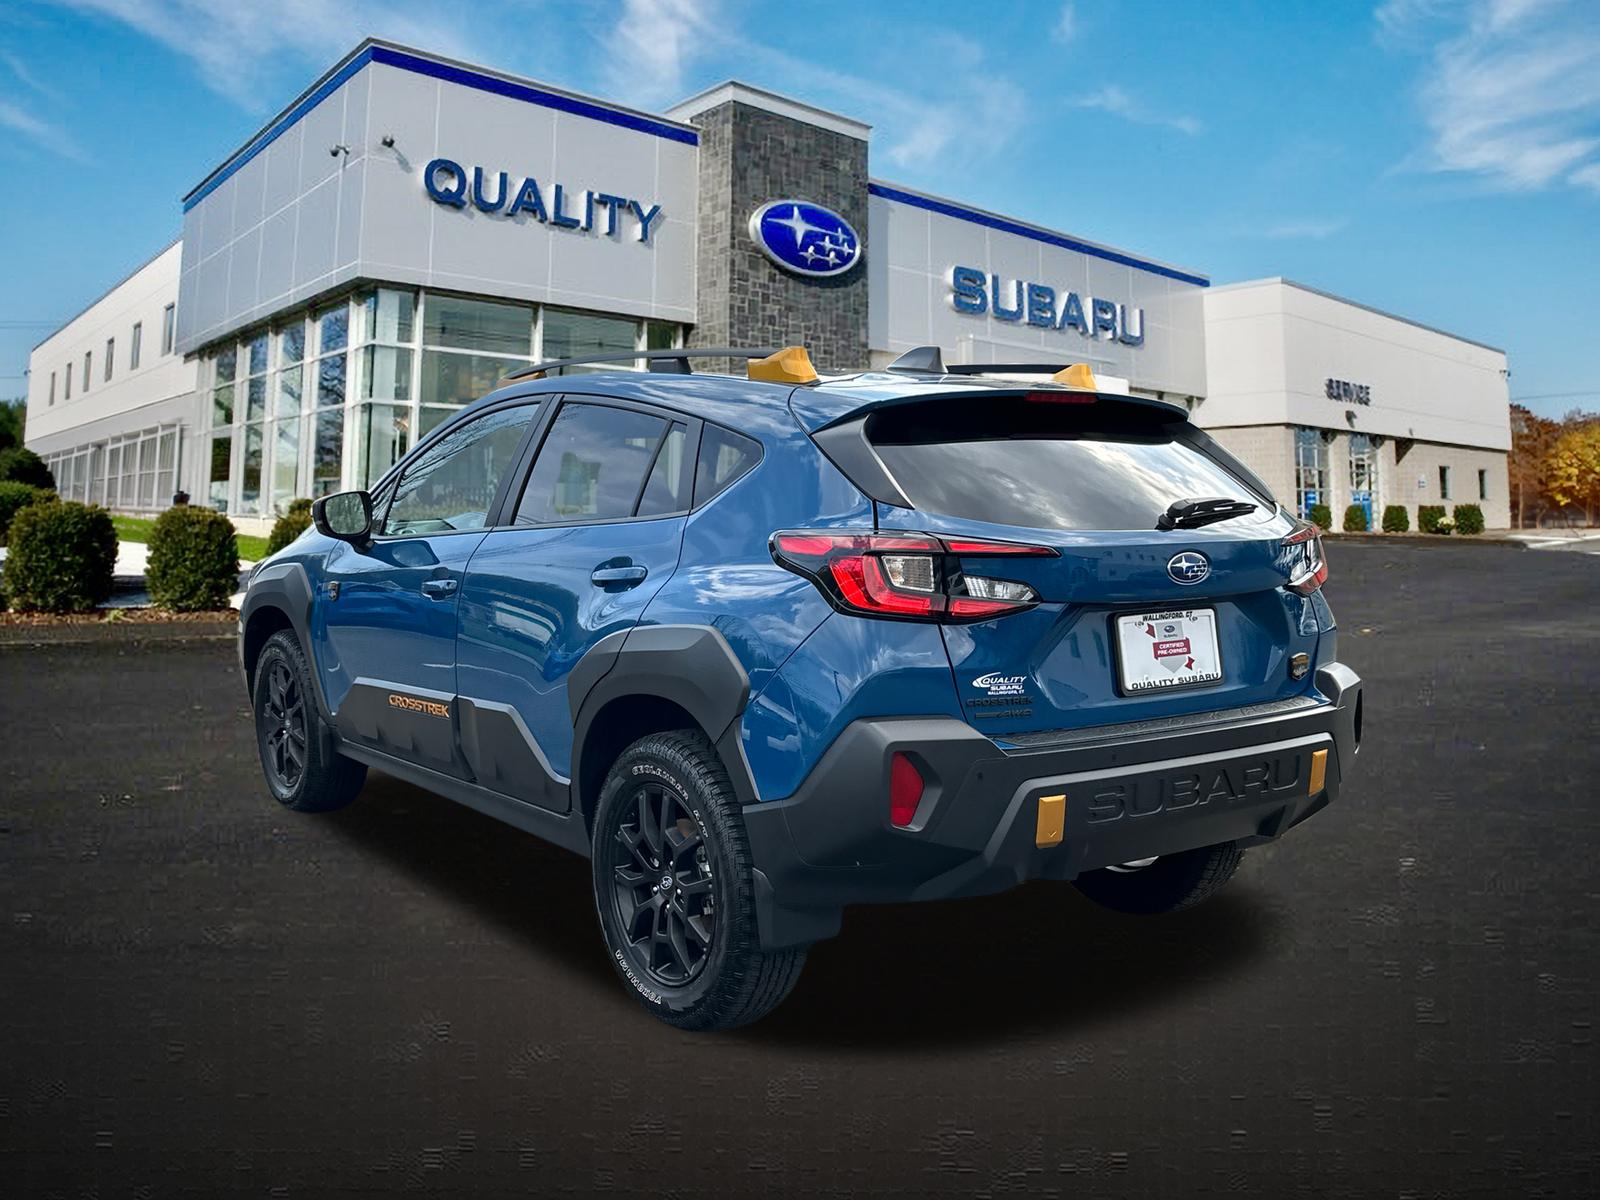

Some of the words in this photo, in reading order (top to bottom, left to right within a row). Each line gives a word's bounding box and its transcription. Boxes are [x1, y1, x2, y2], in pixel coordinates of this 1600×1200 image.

[424, 158, 661, 243] QUALITY
[950, 265, 1145, 347] SUBARU
[1325, 378, 1371, 406] SERVICE
[1157, 647, 1188, 655] PRE-OWNED
[1159, 641, 1185, 650] CERTIFIED
[982, 676, 1027, 684] QUALITY
[1131, 678, 1175, 690] QUALITY
[1178, 672, 1219, 685] SUBARU
[389, 694, 449, 717] CROSSTREK
[967, 696, 1033, 706] CROSSTREK
[1086, 754, 1301, 824] SUBARU
